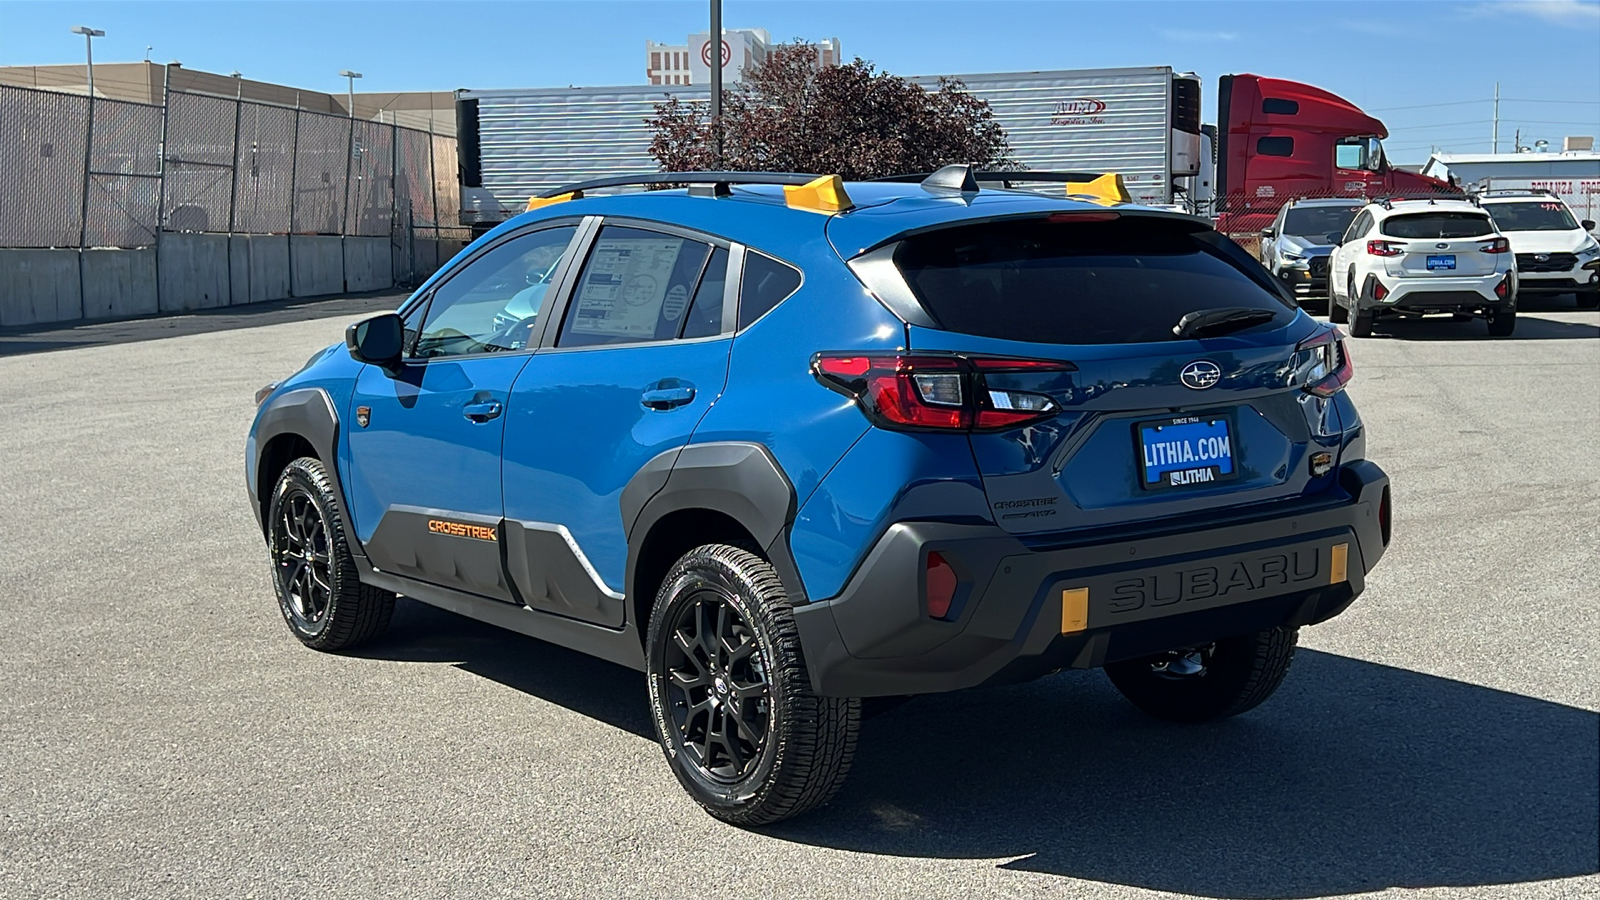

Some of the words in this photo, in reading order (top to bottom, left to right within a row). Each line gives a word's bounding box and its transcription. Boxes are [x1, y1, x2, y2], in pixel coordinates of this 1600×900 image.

[1172, 417, 1187, 425] SINCE
[1143, 435, 1232, 467] LITHIA.COM
[1180, 467, 1215, 485] LITHIA
[994, 496, 1058, 510] CROSSTREK
[428, 519, 498, 541] CROSSTREK
[1107, 547, 1321, 615] SUBARU
